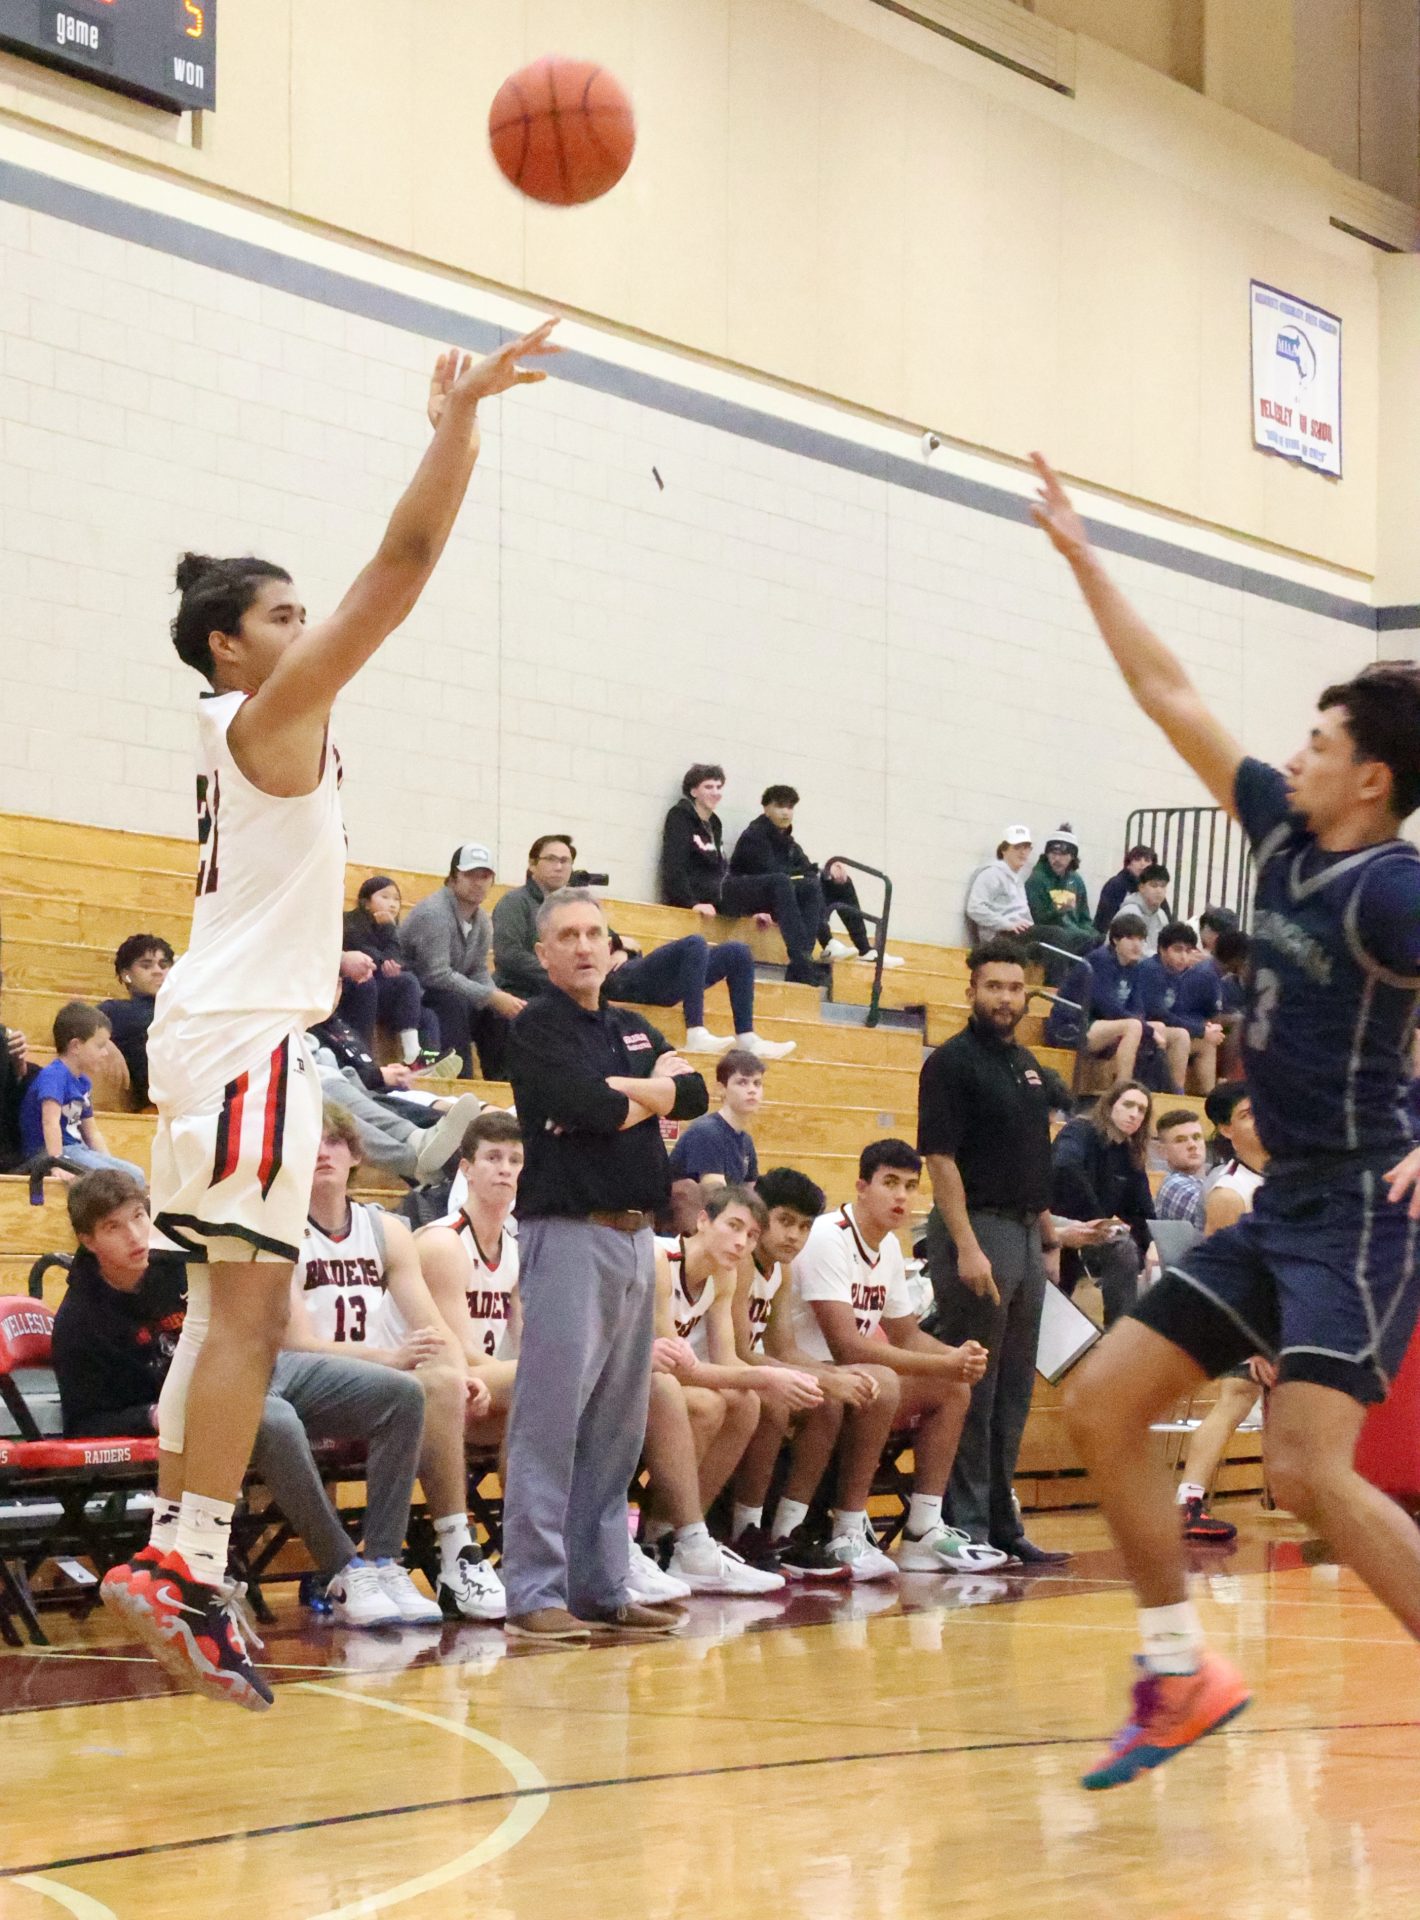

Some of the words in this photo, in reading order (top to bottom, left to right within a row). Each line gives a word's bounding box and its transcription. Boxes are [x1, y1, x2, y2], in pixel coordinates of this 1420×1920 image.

[57, 12, 99, 49] game
[184, 0, 204, 38] 5
[173, 56, 204, 90] won
[1, 1312, 55, 1342] WELLESLE
[334, 1294, 368, 1342] 13
[84, 1447, 131, 1464] RAIDERS
